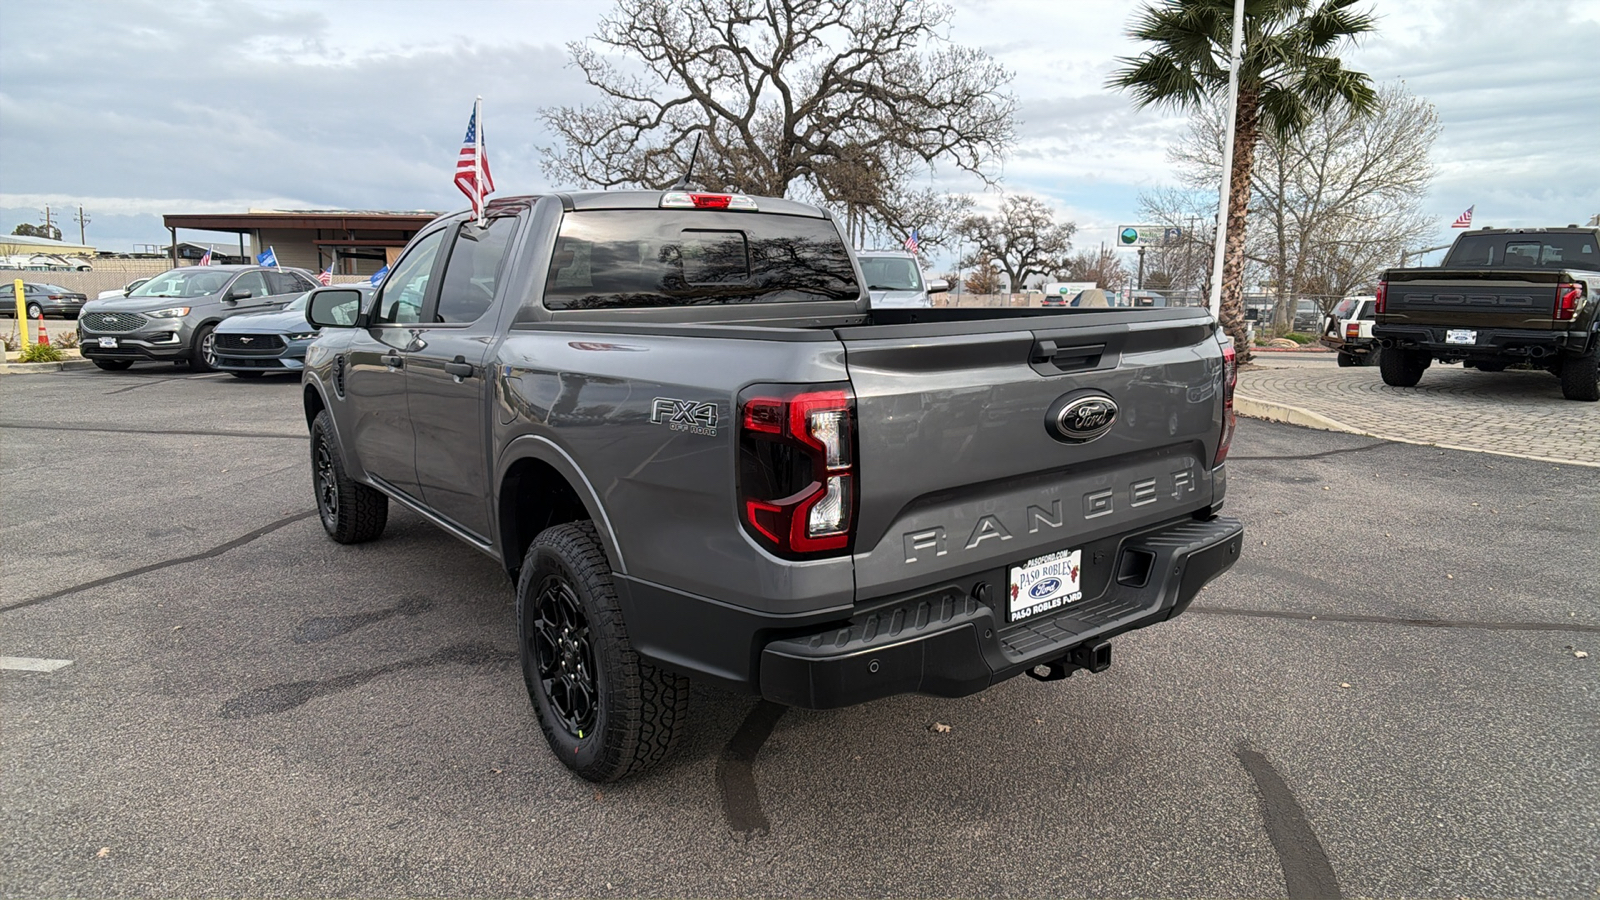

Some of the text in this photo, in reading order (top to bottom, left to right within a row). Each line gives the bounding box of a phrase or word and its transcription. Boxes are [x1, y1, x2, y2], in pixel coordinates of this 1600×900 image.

[1403, 293, 1533, 306] FORD
[650, 396, 718, 429] FX4
[1074, 405, 1109, 429] Ford
[670, 423, 717, 436] OFF ROAD
[903, 470, 1195, 563] RANGER
[1020, 560, 1072, 590] PASO ROBLES
[1035, 580, 1058, 597] Ford
[1011, 592, 1082, 622] PASO ROBLES FORD
